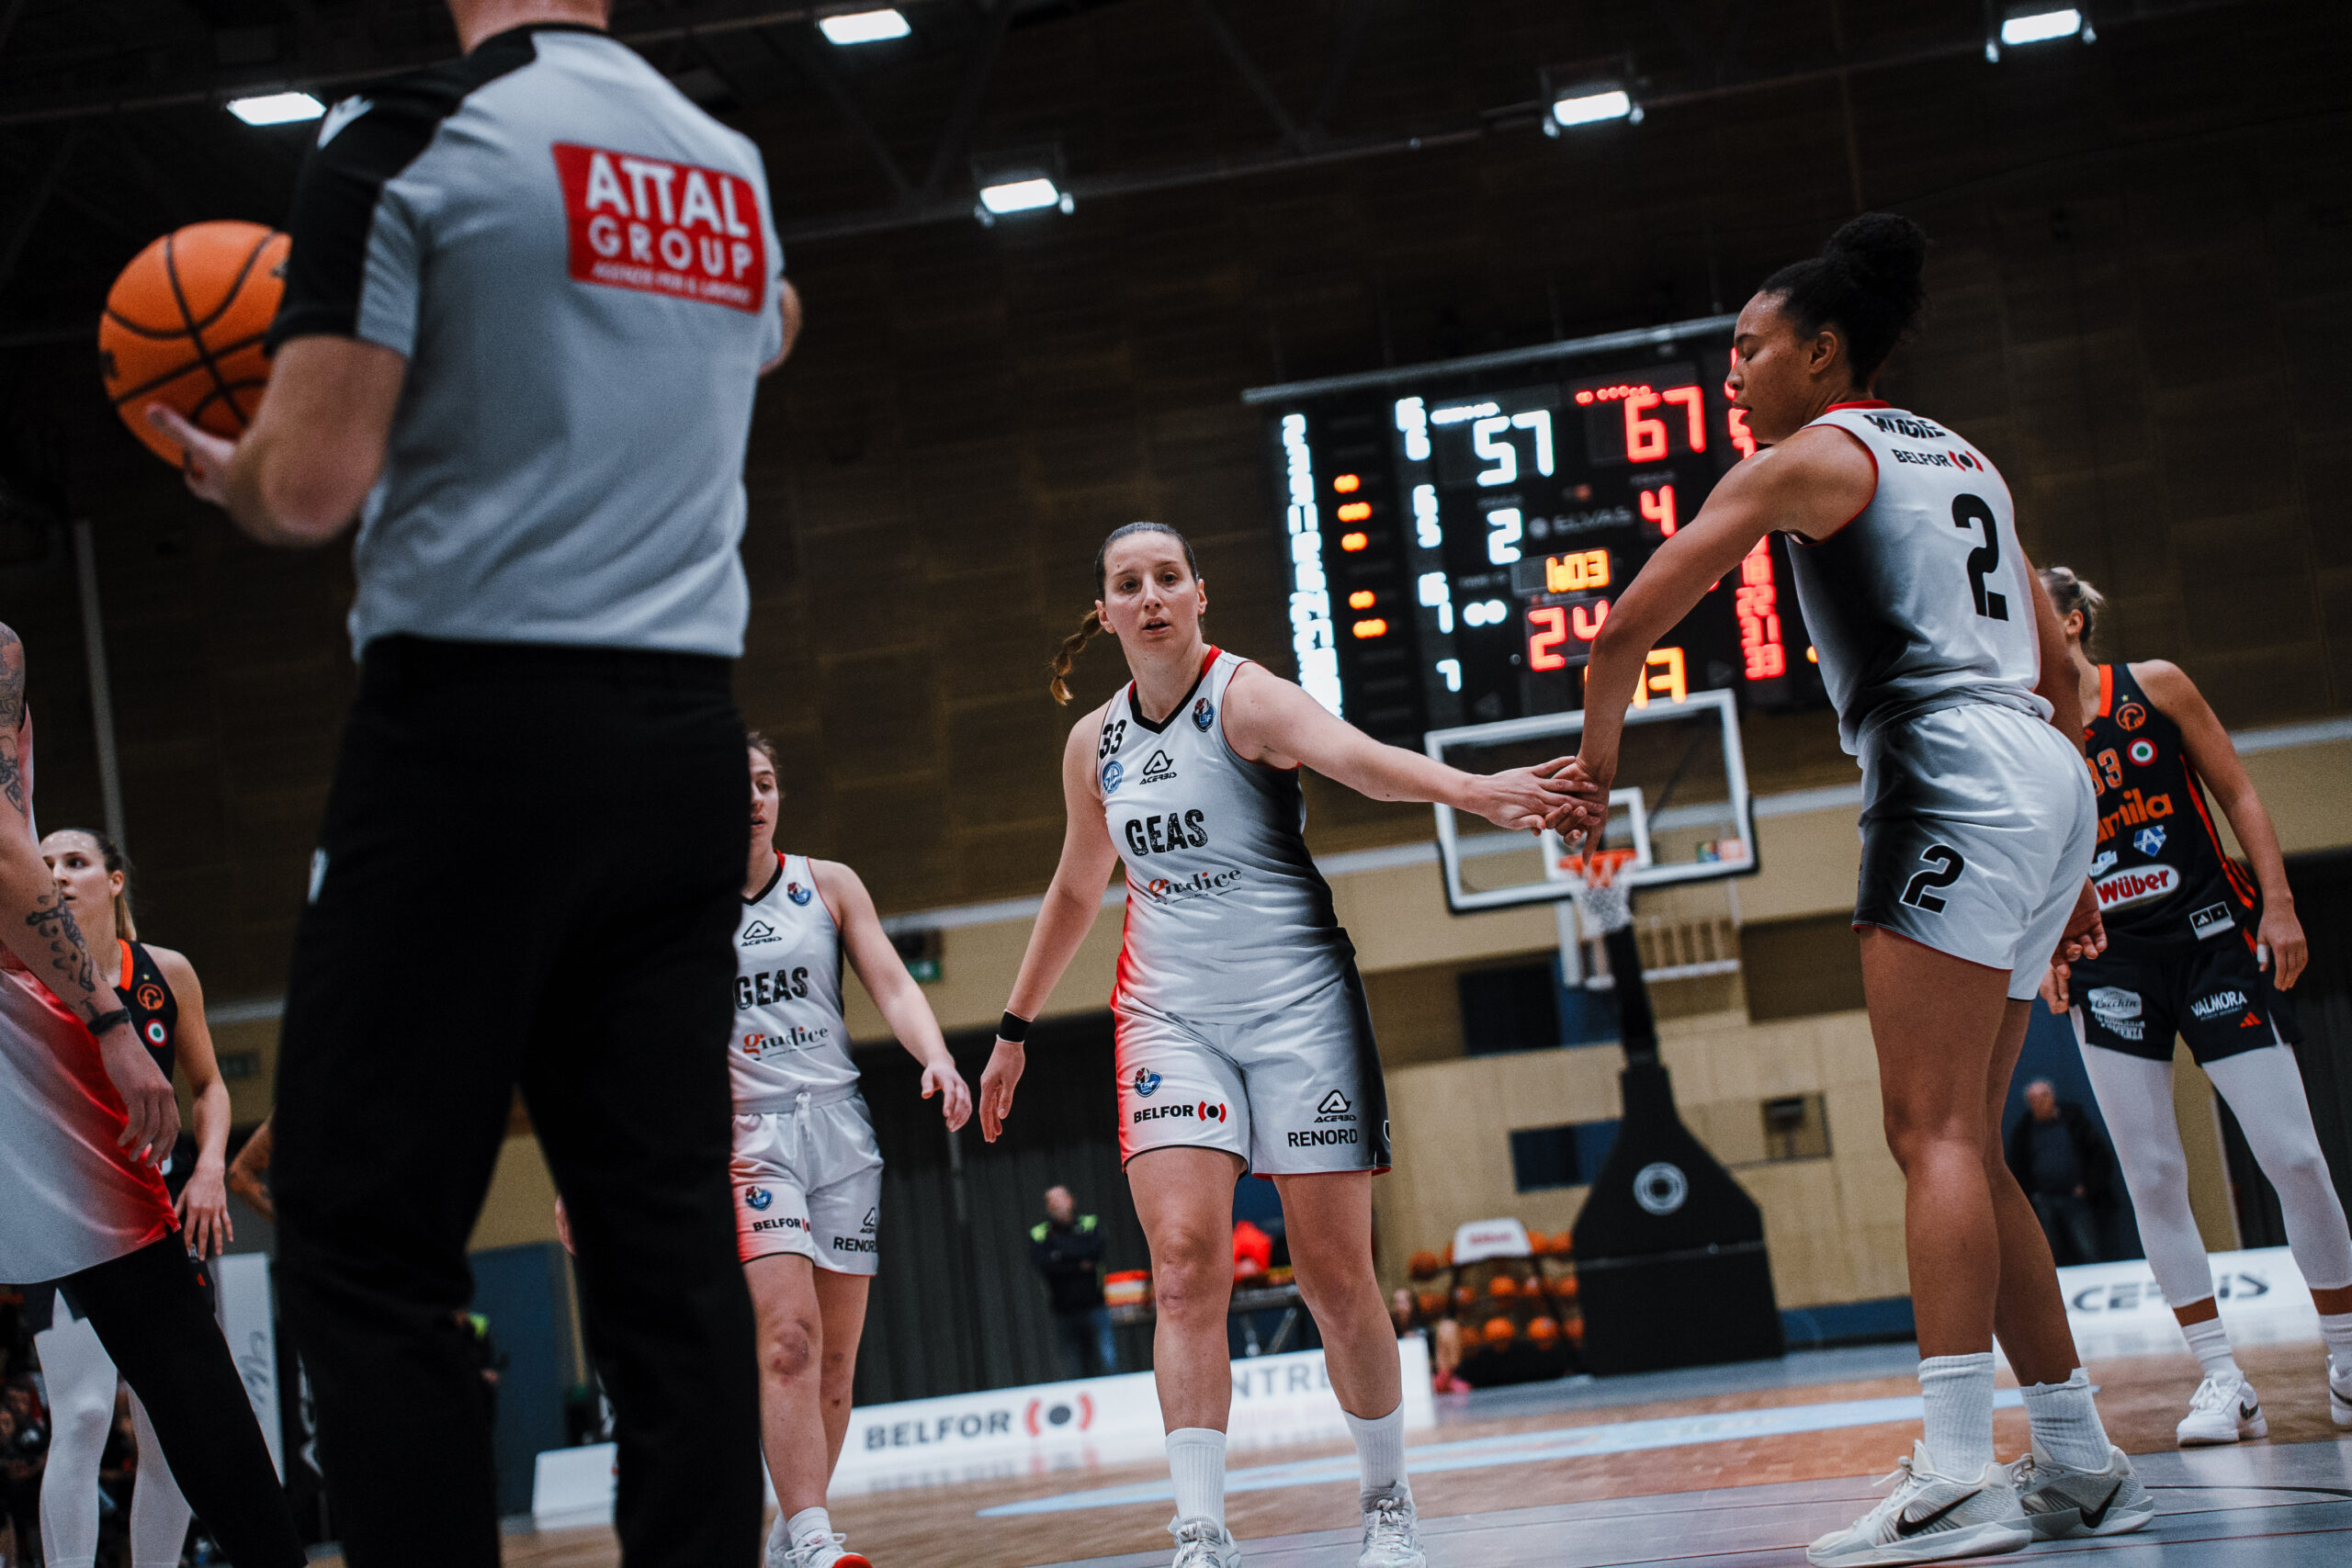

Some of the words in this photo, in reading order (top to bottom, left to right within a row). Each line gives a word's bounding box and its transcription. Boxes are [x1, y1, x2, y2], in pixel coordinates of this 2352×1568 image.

[585, 152, 750, 239] ATTAL
[588, 215, 753, 279] GROUP
[1624, 386, 1706, 463] 67
[1473, 410, 1555, 487] 57
[1891, 448, 1953, 468] BELFOR
[1640, 485, 1677, 538] 4
[1487, 508, 1522, 565] 2
[1951, 493, 2009, 621] 2
[1100, 719, 1127, 760] 33
[1125, 808, 1208, 856] GEAS
[1899, 842, 1965, 916] 2
[2096, 869, 2169, 904] Wüber
[734, 966, 809, 1010] GEAS
[2190, 990, 2248, 1017] VALMORA
[742, 1026, 828, 1055] giudice
[1134, 1105, 1194, 1124] BELFOR
[1287, 1128, 1358, 1147] RENORD
[752, 1218, 801, 1232] BELFOR
[833, 1236, 877, 1253] RENOR
[865, 1409, 1012, 1450] BELFOR
